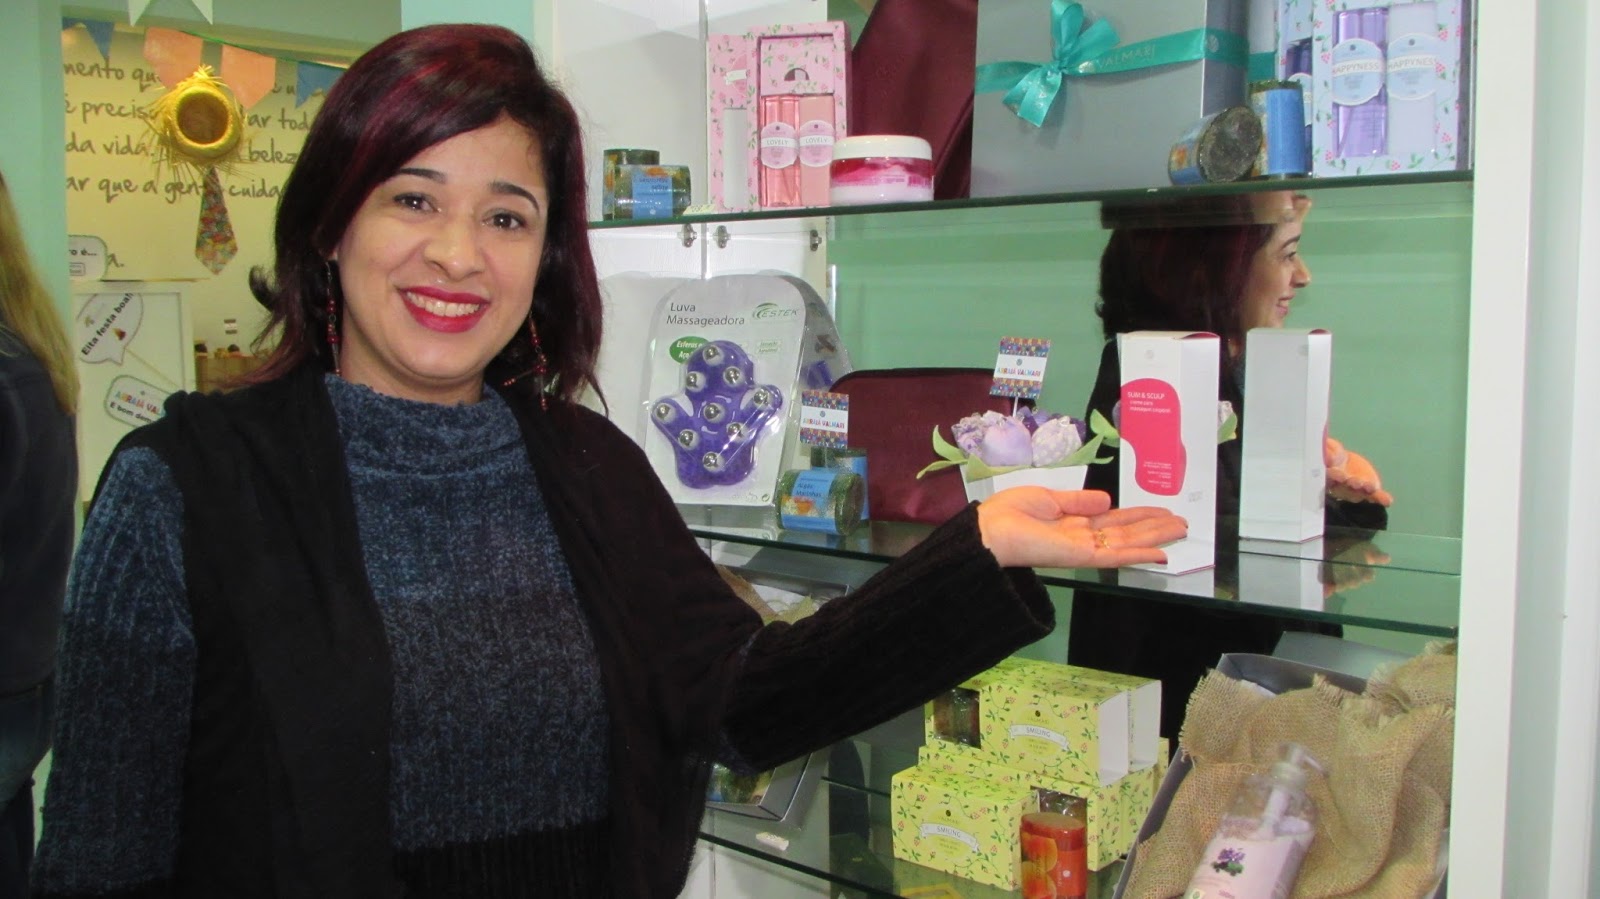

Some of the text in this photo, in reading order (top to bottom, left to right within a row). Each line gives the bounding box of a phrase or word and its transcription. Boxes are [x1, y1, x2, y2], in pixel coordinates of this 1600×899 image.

[278, 107, 310, 130] tod
[248, 137, 297, 163] belez
[98, 178, 138, 203] que
[143, 180, 157, 194] a
[670, 302, 696, 312] Luva
[666, 314, 745, 328] Massageadora
[81, 337, 99, 355] Eita
[96, 314, 117, 337] festa
[1026, 727, 1050, 737] SMILING
[937, 826, 961, 838] SMILING
